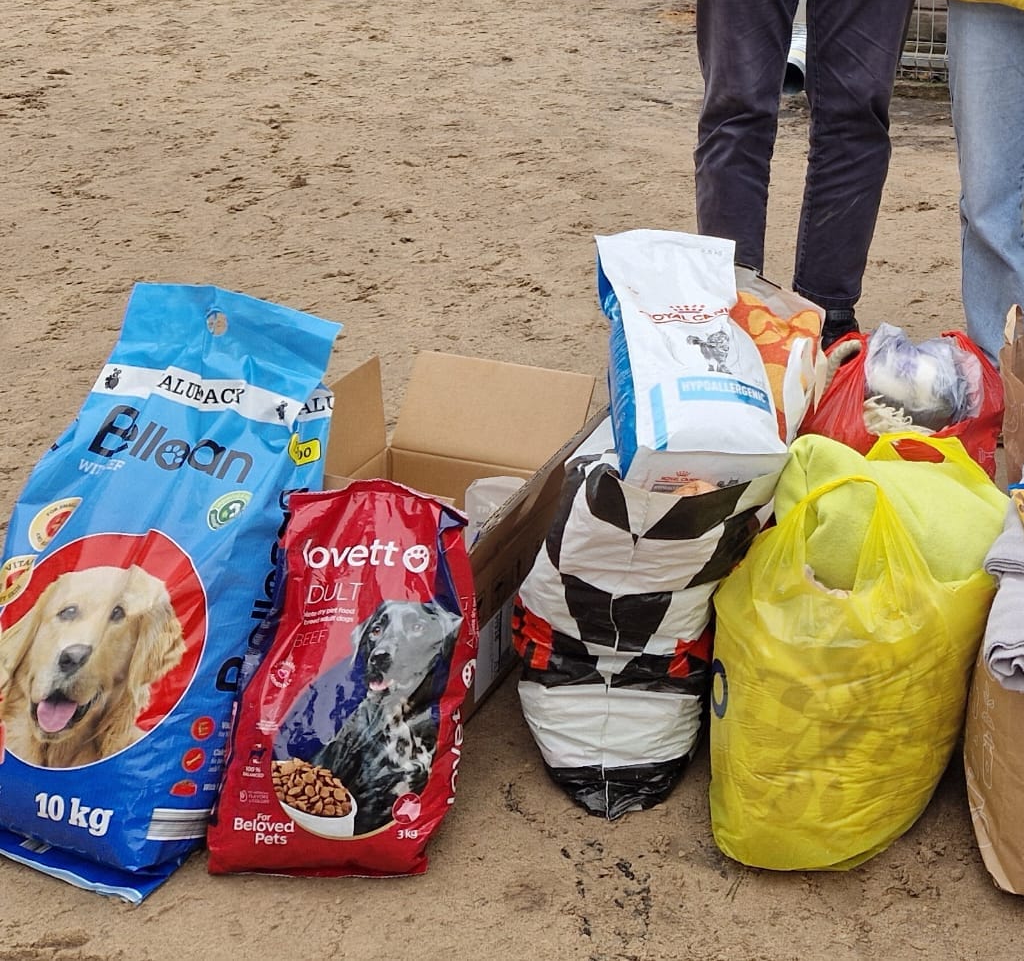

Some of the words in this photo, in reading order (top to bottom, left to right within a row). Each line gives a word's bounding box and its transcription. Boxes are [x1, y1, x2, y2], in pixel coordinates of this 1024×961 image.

[681, 380, 768, 403] HYPOALLERGENIC
[306, 582, 363, 604] DULT
[35, 792, 65, 821] 10
[68, 797, 114, 837] kg
[257, 813, 272, 821] For
[233, 817, 295, 833] Beloved
[255, 832, 288, 845] Pets
[397, 829, 404, 839] 3
[404, 828, 418, 840] kg
